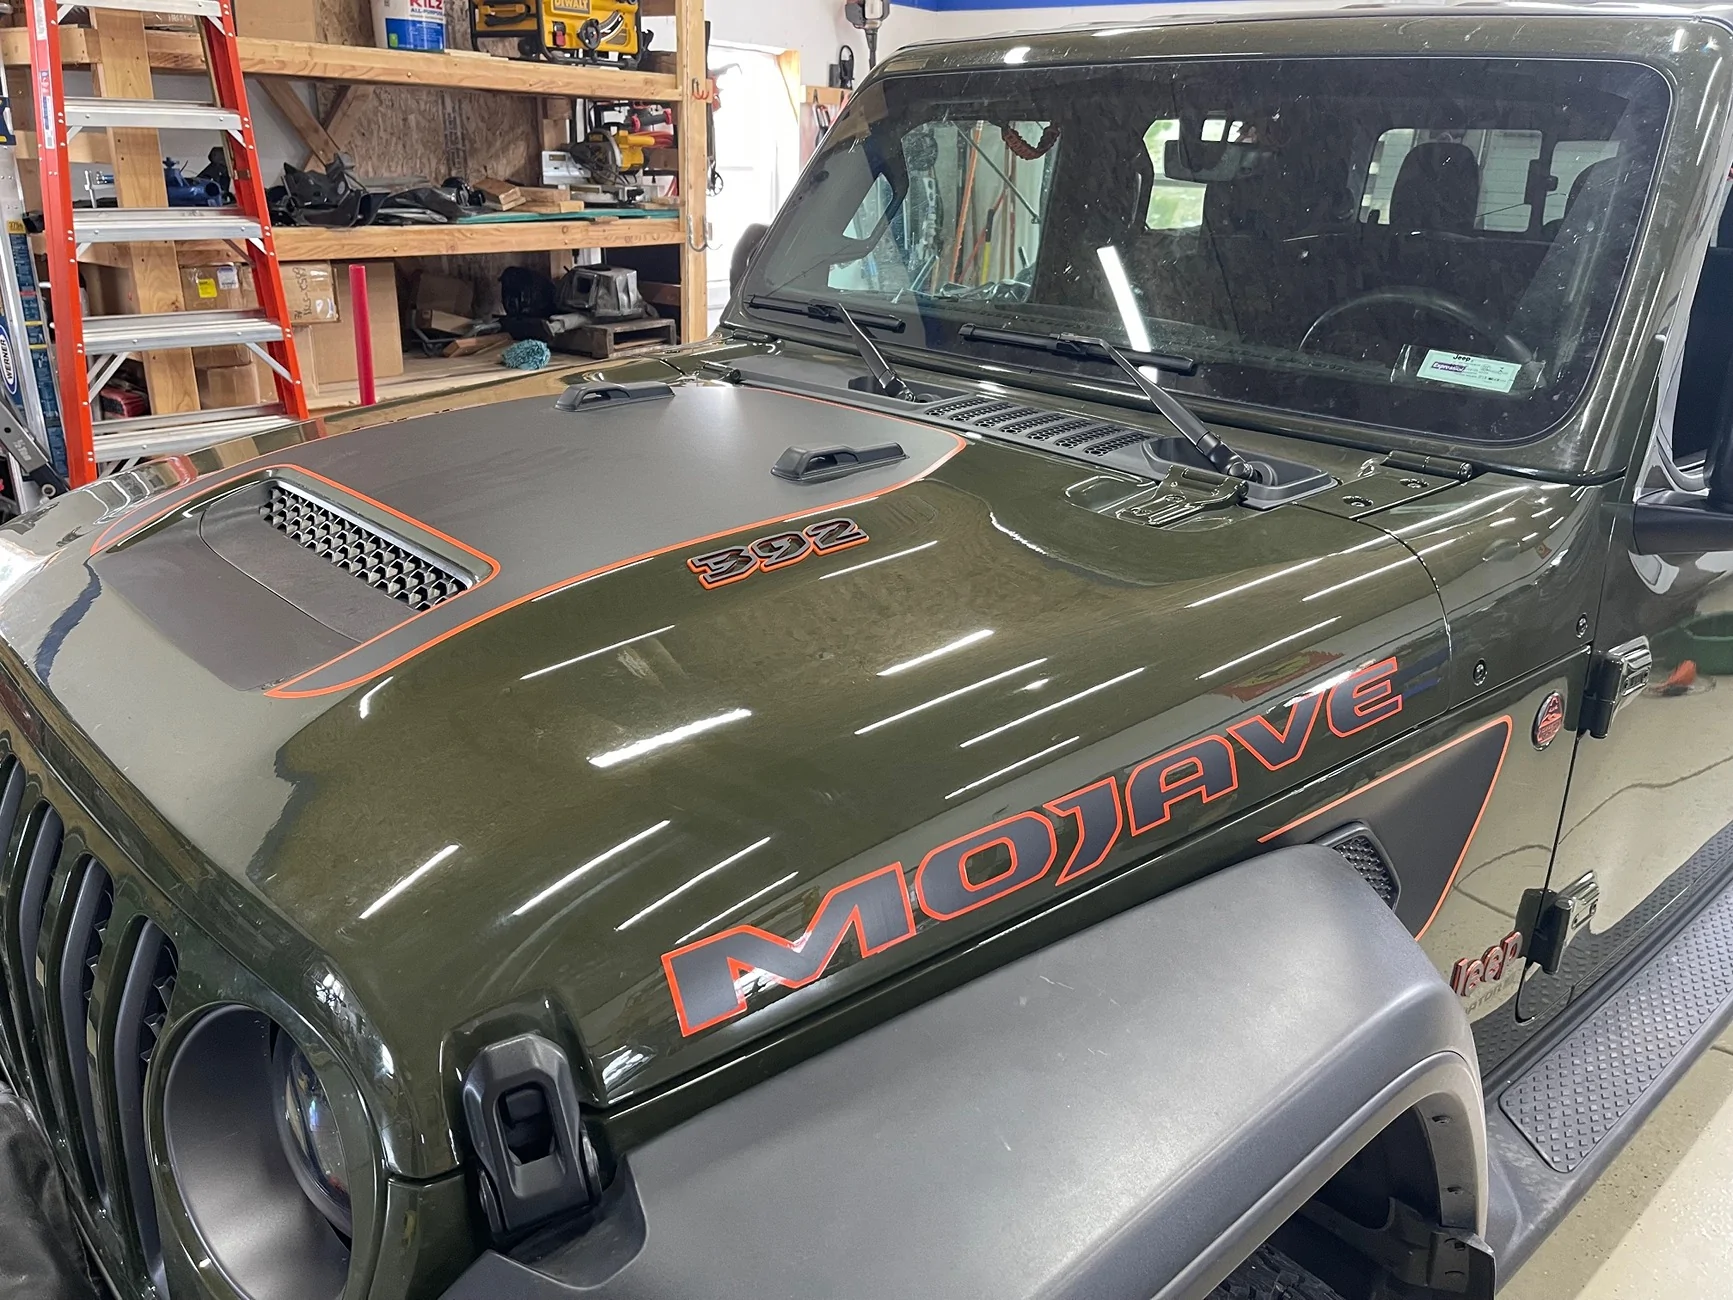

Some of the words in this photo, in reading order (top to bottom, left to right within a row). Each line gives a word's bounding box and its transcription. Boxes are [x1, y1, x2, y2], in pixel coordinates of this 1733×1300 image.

[1, 339, 13, 380] WERNER
[1452, 353, 1471, 362] Jeep
[687, 517, 869, 589] 392
[660, 656, 1404, 1038] MOJAVE
